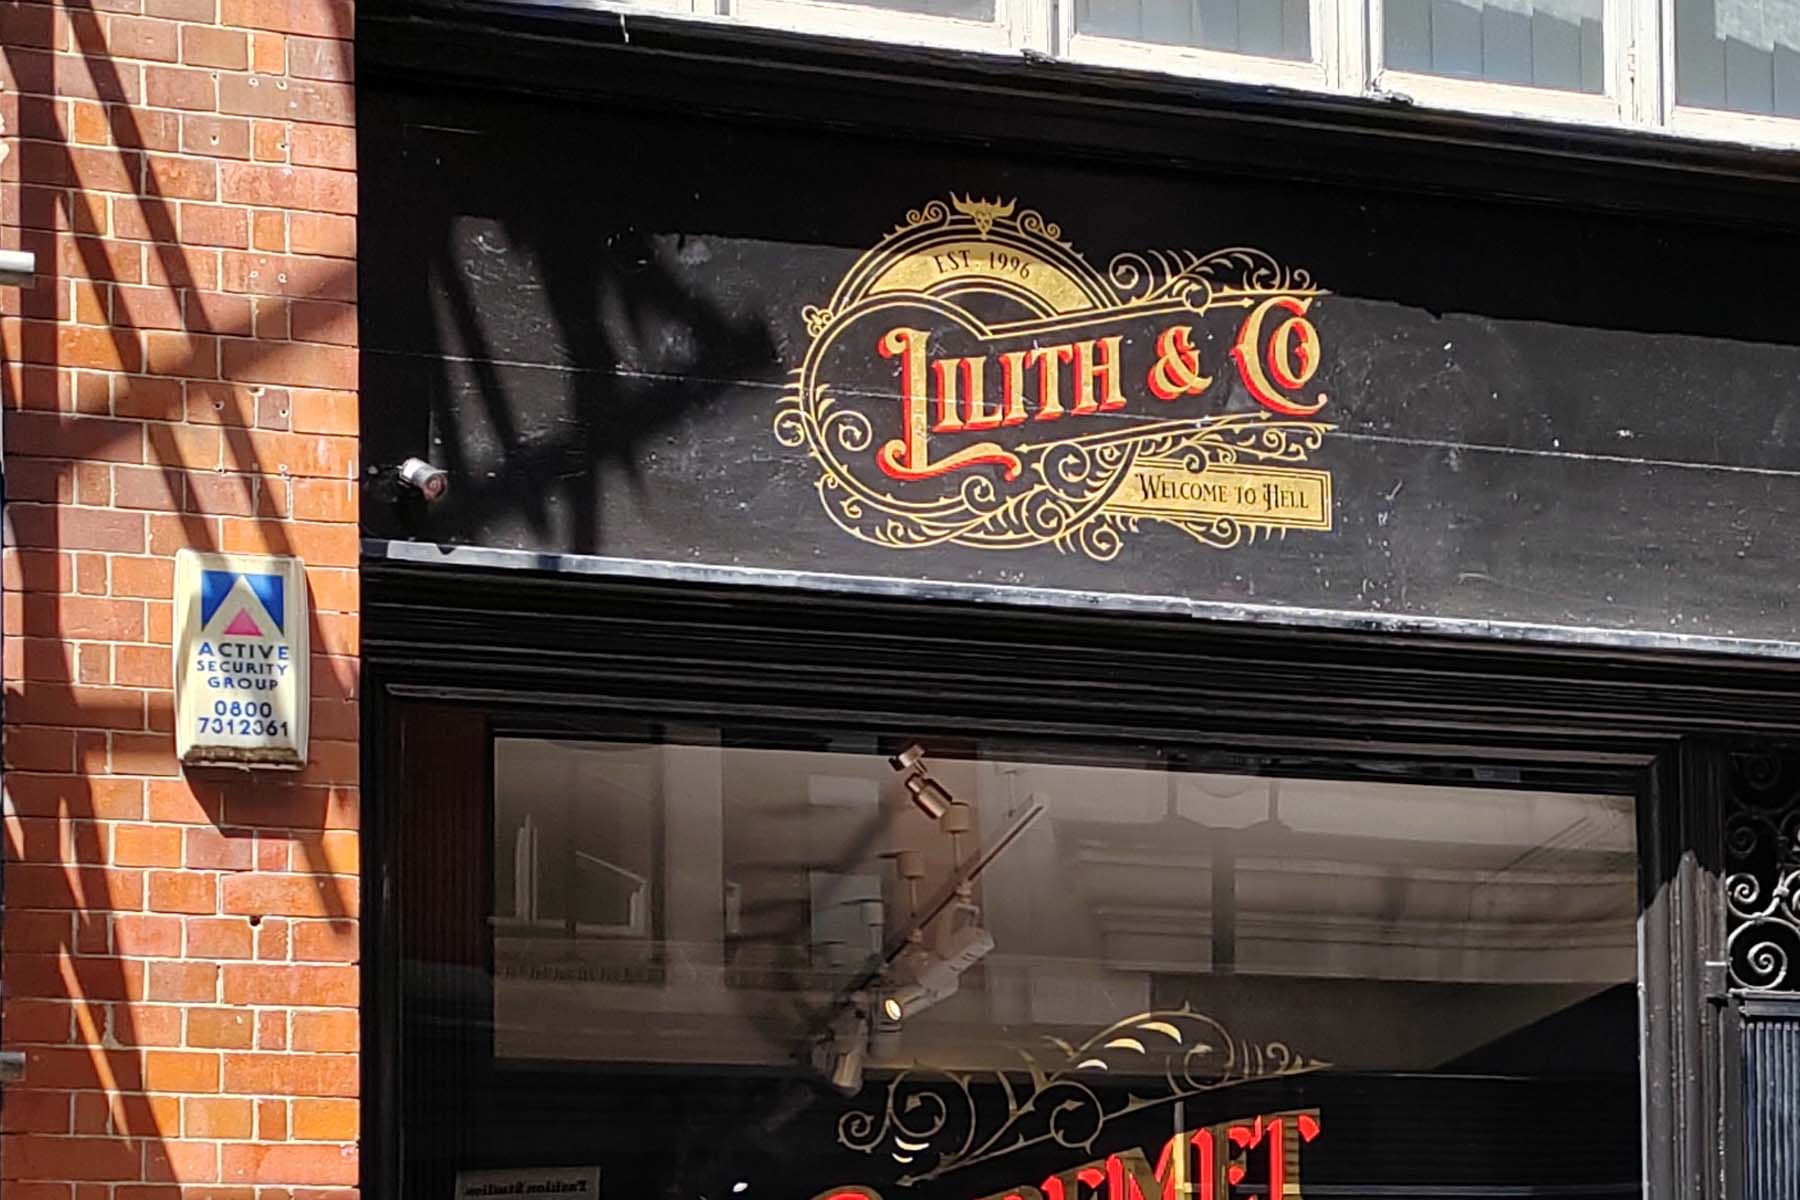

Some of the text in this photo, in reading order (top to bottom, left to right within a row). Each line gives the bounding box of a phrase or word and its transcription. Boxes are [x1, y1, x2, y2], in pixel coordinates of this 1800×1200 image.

[989, 251, 1031, 279] 1996
[877, 295, 1328, 481] LILITH & CO
[1135, 473, 1309, 512] WELCOME TO HELL
[198, 642, 289, 660] ACTIVE
[196, 660, 288, 676] SECURITY
[208, 676, 278, 691] GROUP
[214, 700, 272, 718] 0800
[198, 717, 289, 737] 7312361
